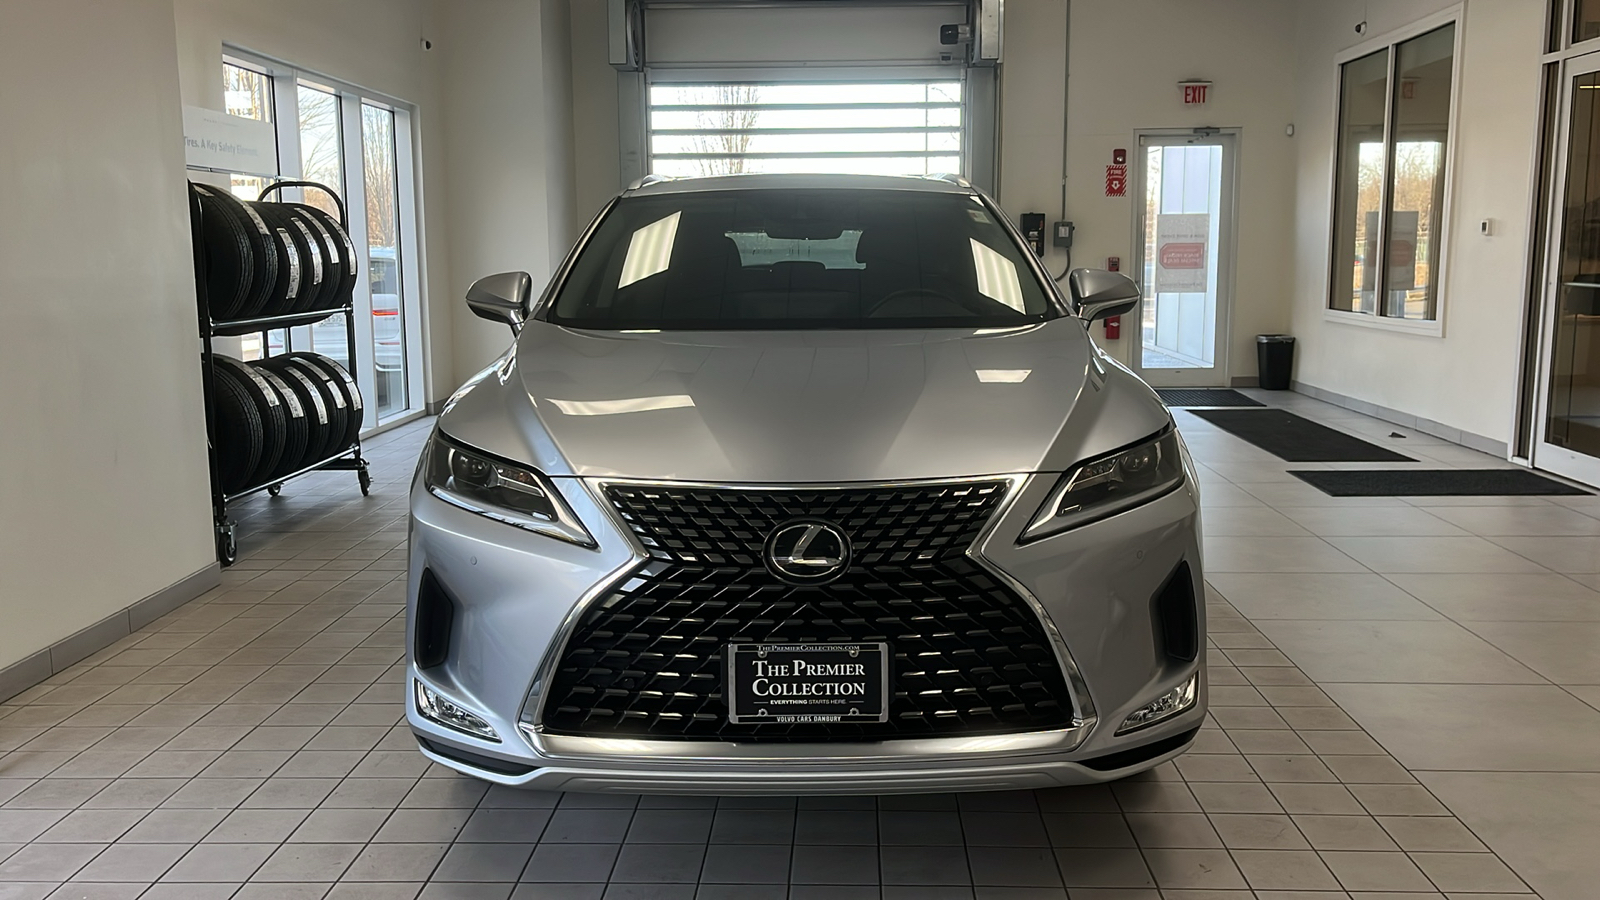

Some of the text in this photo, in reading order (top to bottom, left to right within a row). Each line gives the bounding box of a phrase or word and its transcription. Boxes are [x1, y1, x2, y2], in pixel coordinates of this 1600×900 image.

[1184, 85, 1208, 104] EXIT
[201, 138, 206, 149] A
[206, 139, 217, 153] Key
[219, 141, 236, 156] Safety
[752, 659, 866, 677] THE PREMIER
[752, 678, 866, 696] COLLECTION
